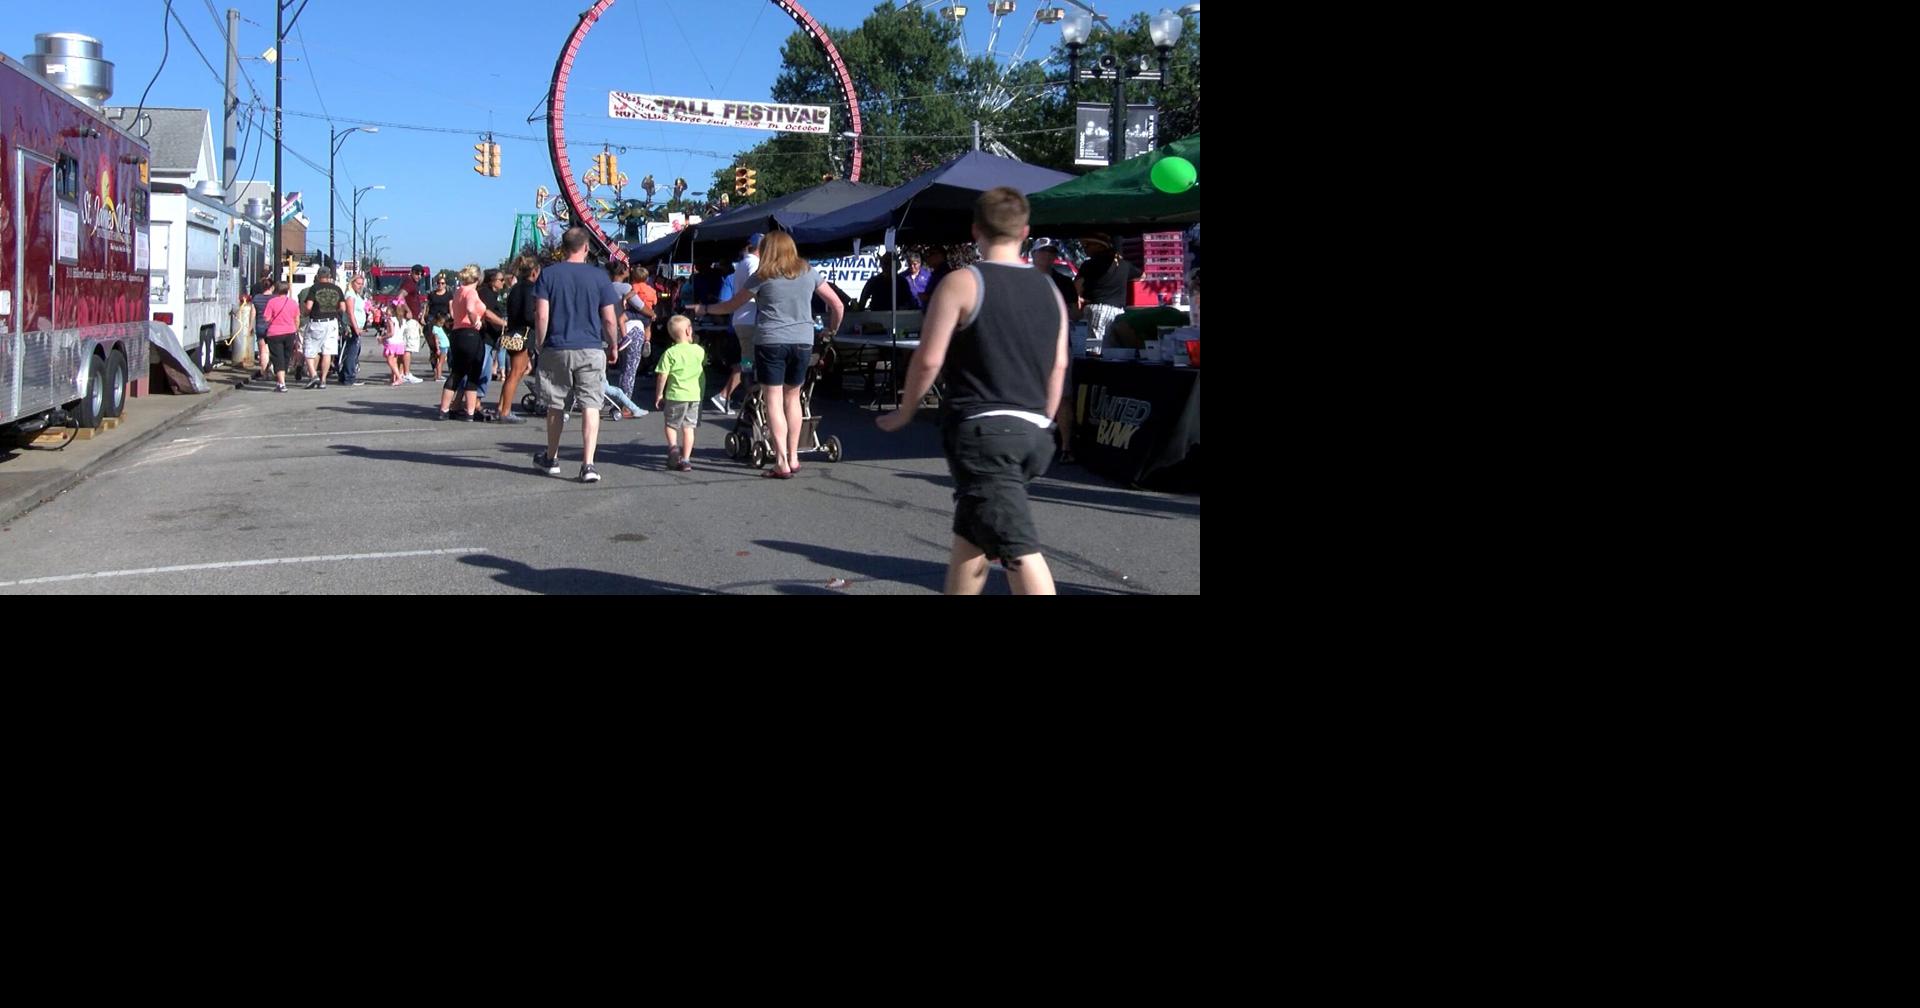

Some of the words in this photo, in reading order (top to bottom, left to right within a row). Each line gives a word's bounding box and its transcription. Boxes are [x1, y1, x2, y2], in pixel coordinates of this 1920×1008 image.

[660, 98, 714, 117] FALL
[722, 103, 825, 125] FESTIVAL
[785, 123, 824, 132] October
[1089, 384, 1152, 426] UNITED
[1096, 418, 1140, 450] BANK
